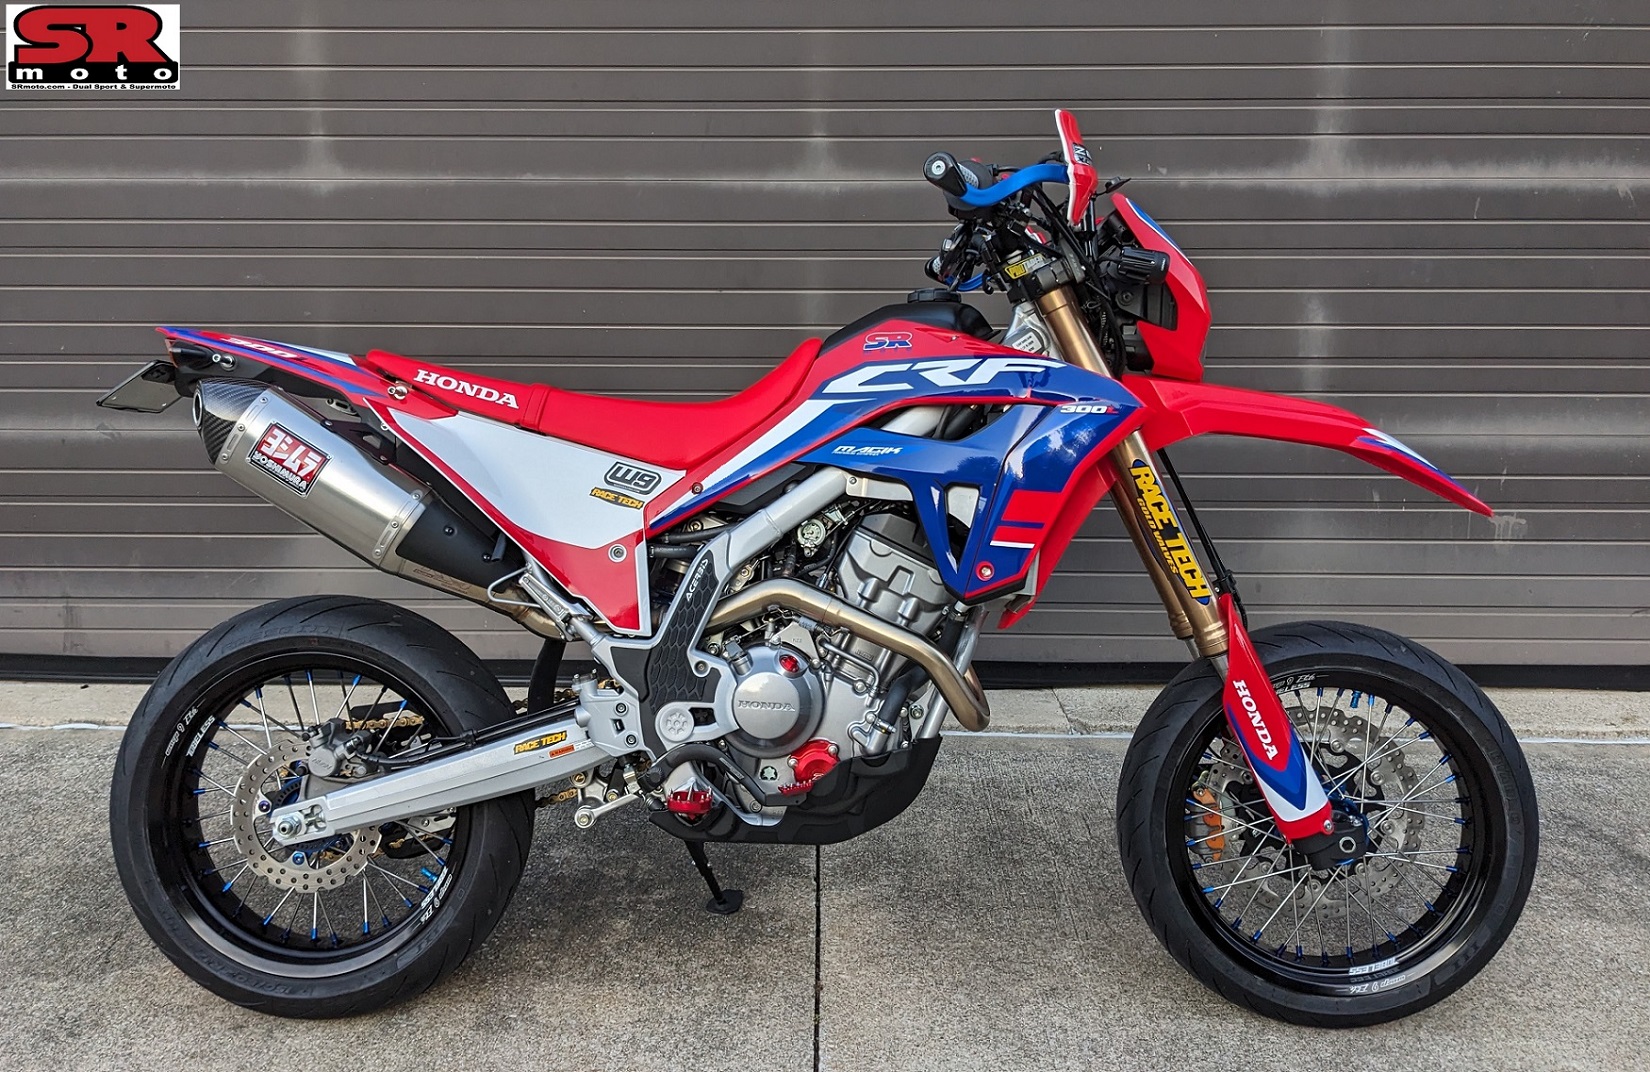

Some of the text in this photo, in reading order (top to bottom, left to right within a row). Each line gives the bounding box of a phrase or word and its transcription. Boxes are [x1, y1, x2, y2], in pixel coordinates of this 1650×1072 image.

[413, 369, 519, 409] HONDA
[822, 357, 1067, 393] CRF
[252, 450, 307, 491] YOSHIMURA
[260, 428, 322, 477] ヨシムラ
[591, 488, 618, 502] RACE
[618, 495, 644, 509] TECH
[1129, 466, 1212, 598] RACE TECH
[1136, 497, 1179, 575] GOLD VALVES
[686, 558, 709, 602] ACERBIS
[737, 700, 796, 711] HONDA
[1232, 679, 1279, 760] HONDA
[515, 740, 540, 753] RACE
[541, 731, 566, 746] TECH
